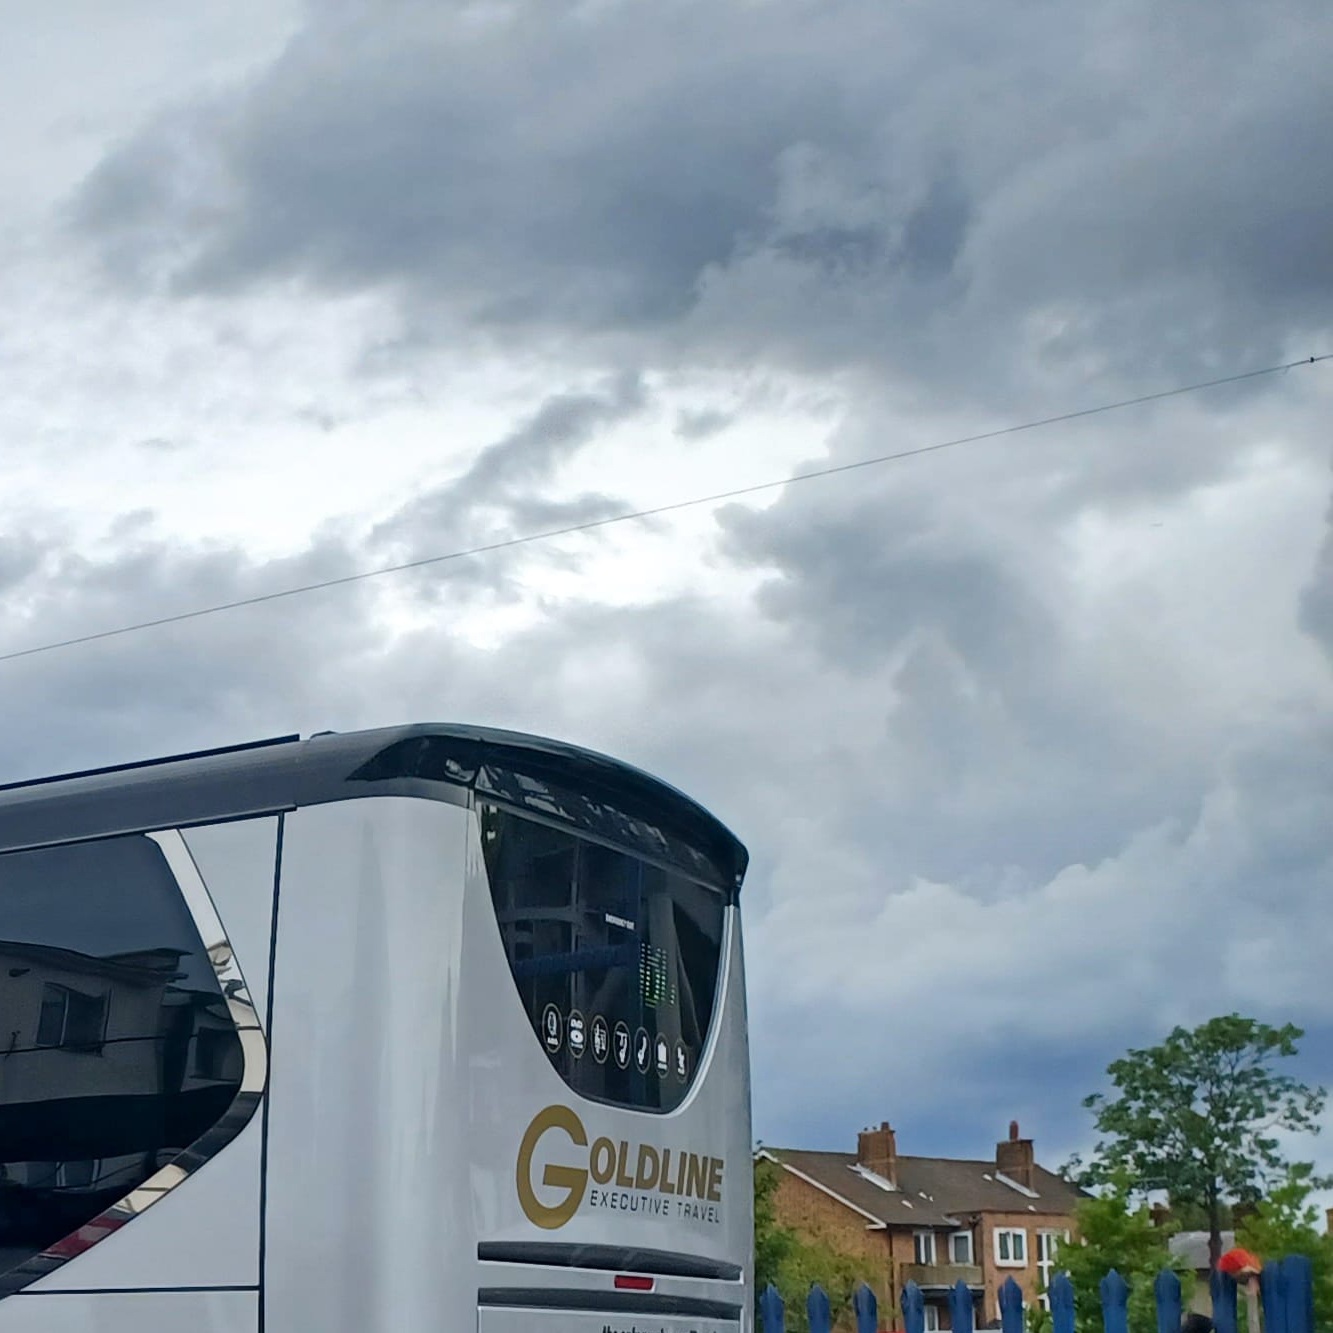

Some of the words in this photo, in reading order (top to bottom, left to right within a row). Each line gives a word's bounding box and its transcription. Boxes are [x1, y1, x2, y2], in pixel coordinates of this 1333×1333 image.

[516, 1104, 725, 1230] GOLDLINE
[590, 1190, 670, 1216] EXECUTIVE
[677, 1202, 720, 1224] TRAVEL
